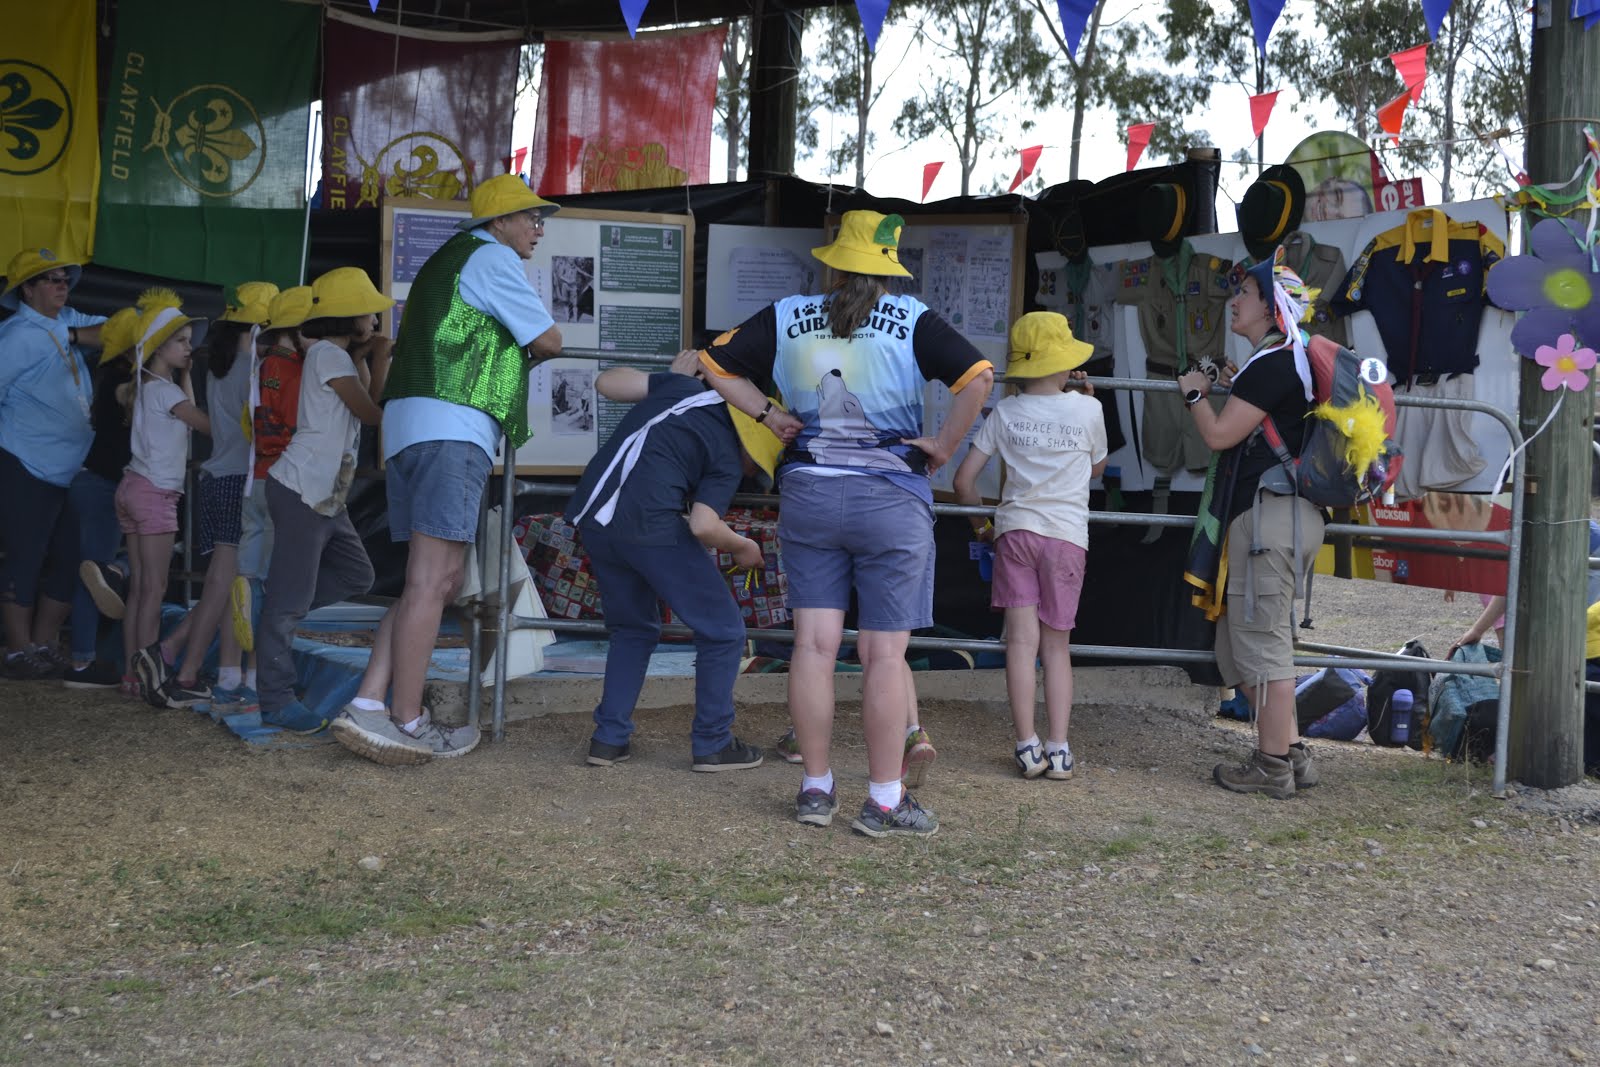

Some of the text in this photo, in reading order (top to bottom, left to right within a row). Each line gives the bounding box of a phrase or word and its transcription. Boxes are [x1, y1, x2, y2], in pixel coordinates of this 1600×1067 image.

[112, 52, 145, 180] CLAYFIELD
[330, 117, 348, 210] CLAYFIE
[872, 300, 909, 321] ARS
[787, 314, 910, 340] CUB OUTS
[1006, 421, 1083, 437] EMBRACE YOUR
[1008, 436, 1080, 450] INNER SHARK
[1375, 508, 1410, 521] DICKSON
[1373, 555, 1394, 568] abor
